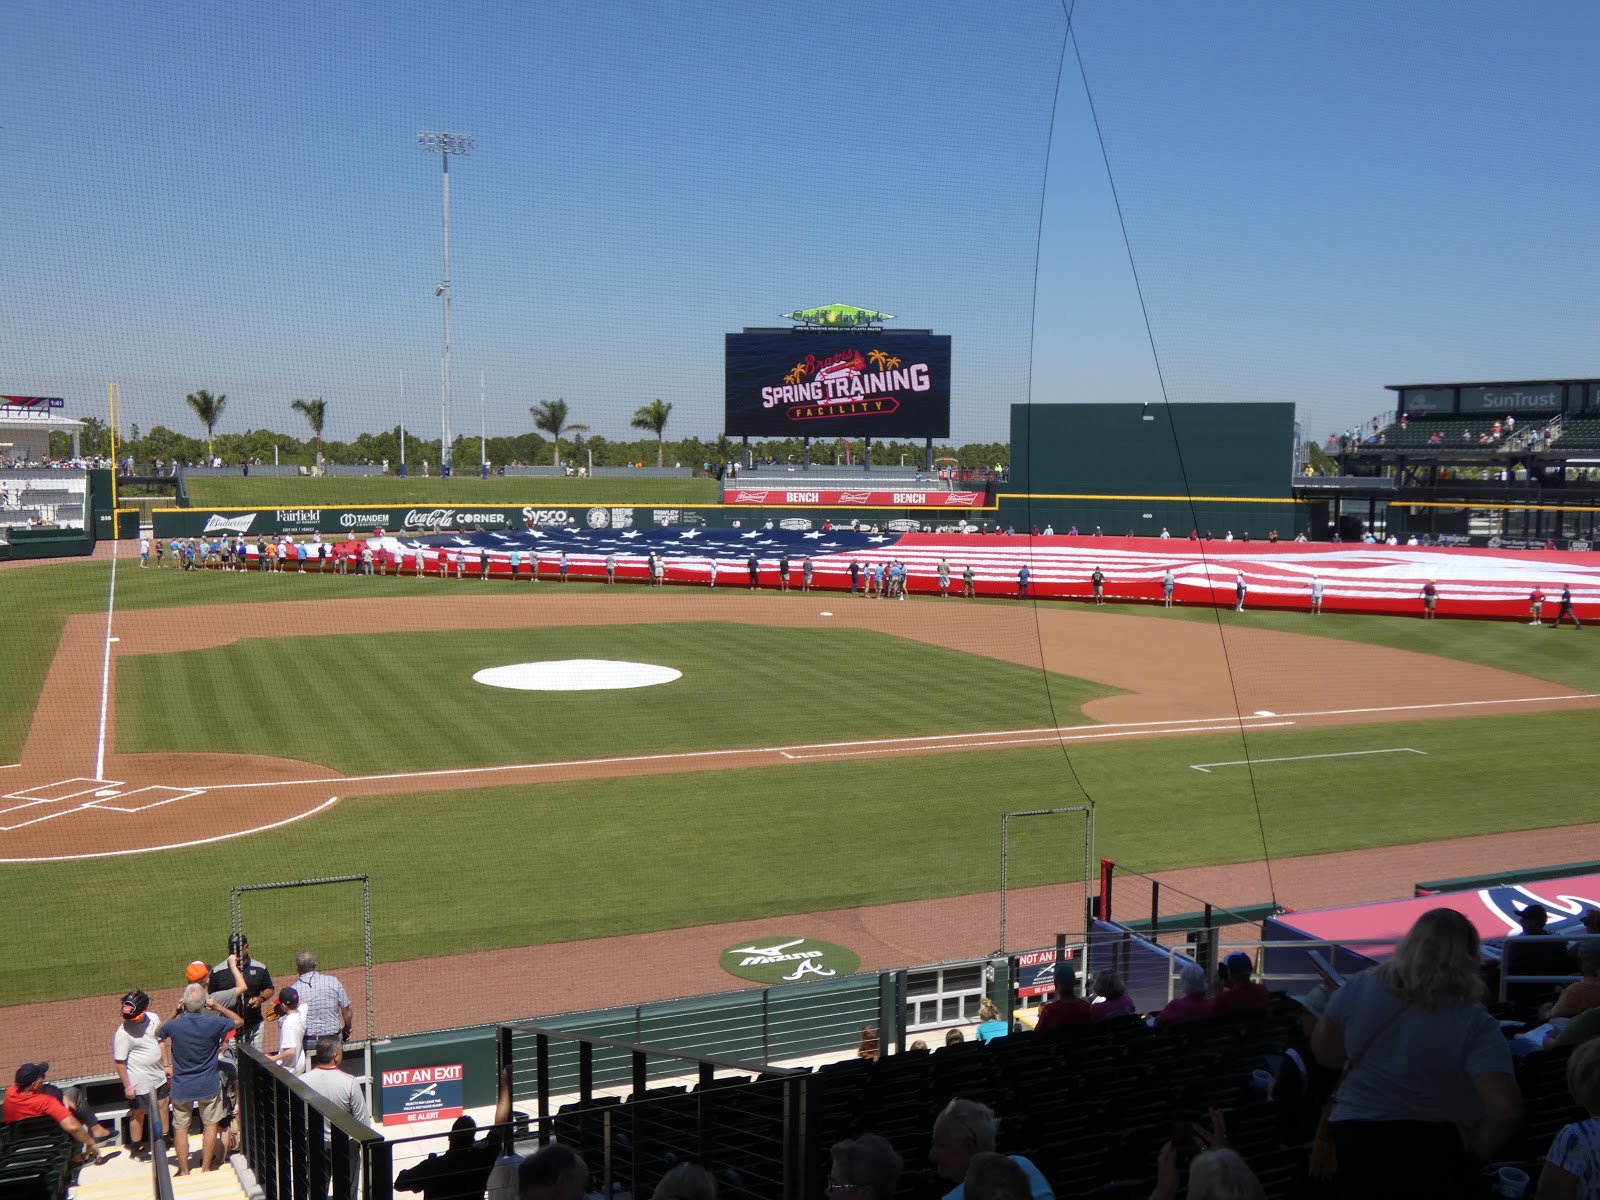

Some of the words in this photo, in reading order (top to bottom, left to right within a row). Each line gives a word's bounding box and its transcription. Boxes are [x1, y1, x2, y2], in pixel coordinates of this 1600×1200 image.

[804, 348, 852, 376] Braves
[762, 381, 822, 408] SPRING
[826, 363, 930, 399] TRAINING
[1482, 392, 1556, 407] SunTrust
[796, 401, 883, 417] FACILITY
[787, 492, 818, 502] BENCH
[894, 493, 926, 504] BENCH
[276, 510, 320, 521] Fairfield
[404, 509, 456, 527] Coca-Cola
[456, 514, 504, 523] CORNER
[522, 507, 567, 524] Sysco
[1020, 954, 1038, 965] NOT
[1039, 952, 1052, 961] AN
[1054, 949, 1071, 960] IT
[383, 1071, 409, 1085] NOT
[412, 1069, 430, 1082] AN
[435, 1066, 462, 1080] EXIT
[418, 1112, 439, 1120] ALERT
